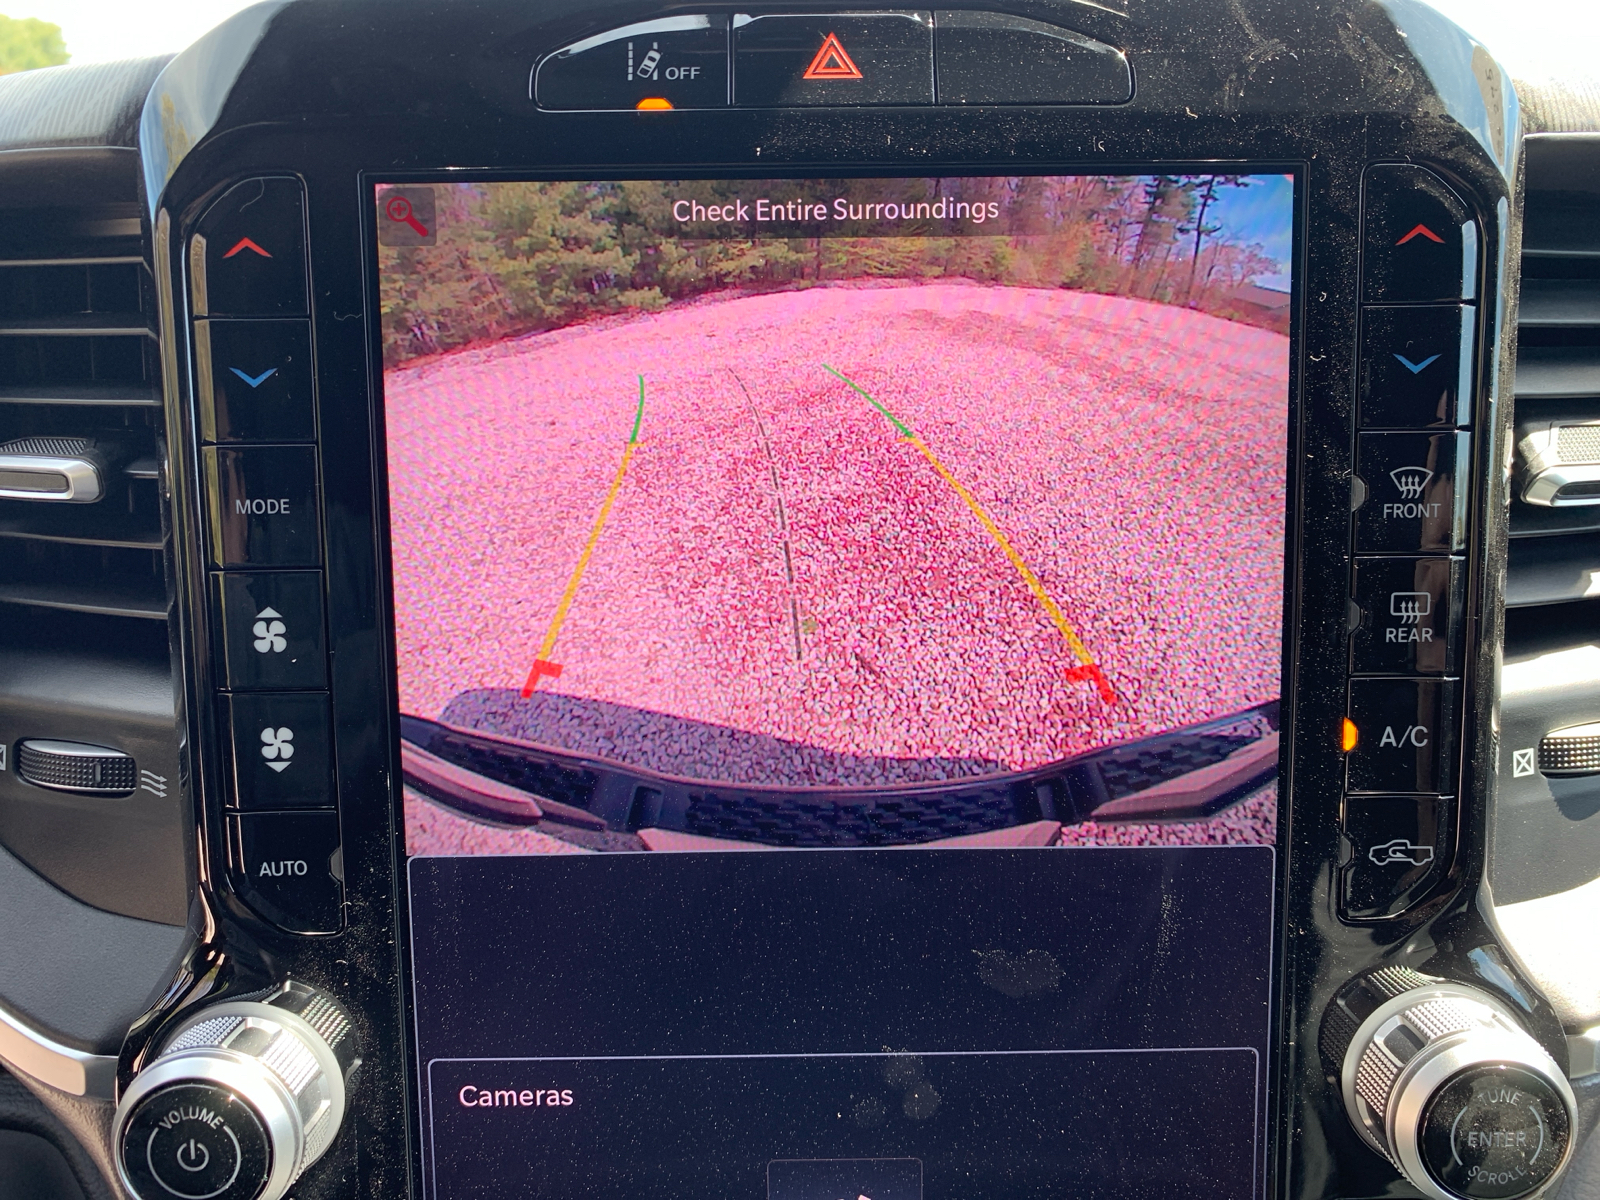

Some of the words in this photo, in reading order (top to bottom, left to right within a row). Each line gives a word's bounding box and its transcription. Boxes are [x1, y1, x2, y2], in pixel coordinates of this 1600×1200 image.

[665, 66, 701, 80] OFF
[673, 199, 749, 223] Check
[756, 199, 828, 222] Entire
[833, 197, 1000, 226] Surroundings
[235, 499, 291, 515] MODE
[1383, 503, 1442, 519] FRONT
[1385, 627, 1433, 643] REAR
[1379, 725, 1429, 748] A/C
[259, 860, 308, 878] AUTO
[458, 1085, 574, 1107] Cameras
[1477, 1088, 1523, 1107] TUNE
[158, 1105, 227, 1132] VOLUME
[1467, 1131, 1527, 1148] ENTER
[1467, 1165, 1529, 1185] SCROLL
